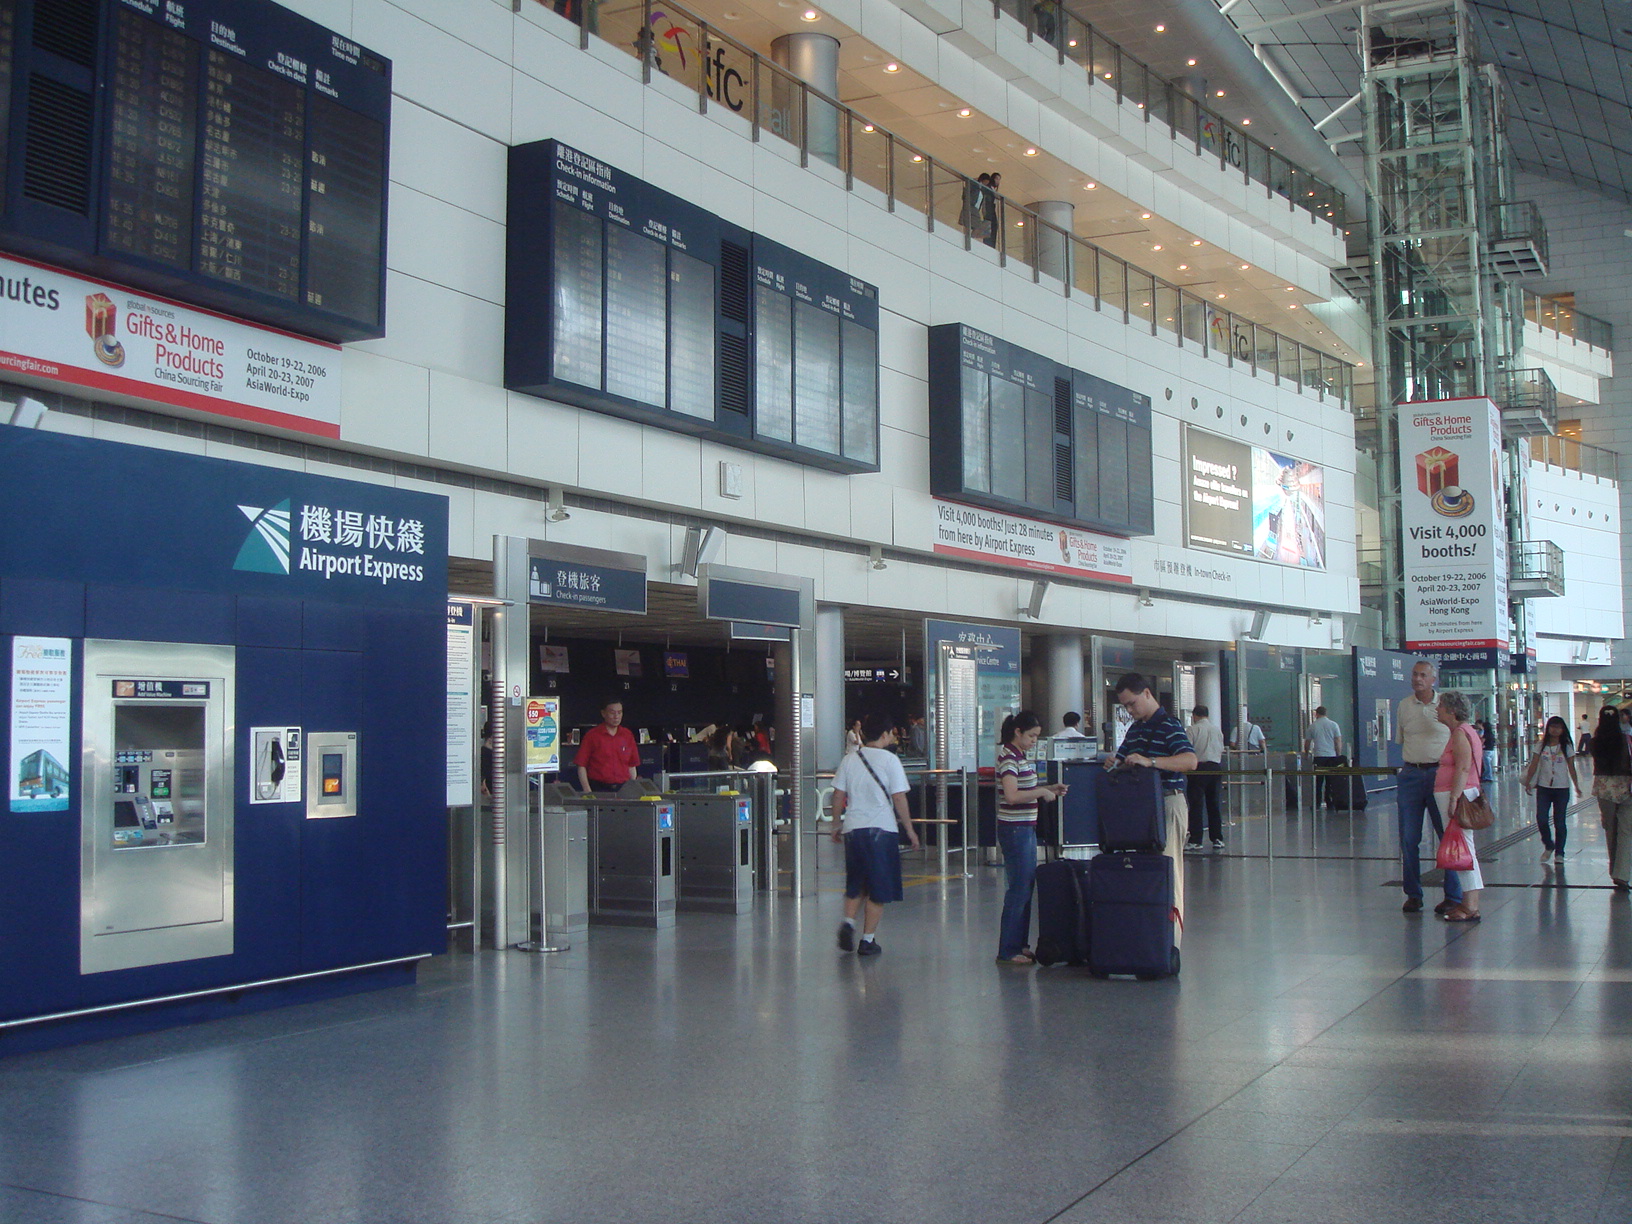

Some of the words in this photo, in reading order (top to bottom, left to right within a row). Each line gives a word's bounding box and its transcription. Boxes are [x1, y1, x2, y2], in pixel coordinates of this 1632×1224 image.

[165, 13, 186, 29] Flight
[210, 33, 247, 57] Destination
[332, 47, 345, 61] Time
[345, 55, 358, 66] now
[268, 59, 293, 78] Check-in
[293, 72, 308, 85] desk
[315, 81, 339, 99] Remarks
[556, 160, 582, 179] Check-in
[583, 171, 617, 194] information
[126, 299, 146, 313] global
[151, 306, 175, 320] sources
[126, 312, 163, 342] Gifts
[166, 322, 177, 345] &
[180, 325, 225, 356] Home
[155, 345, 225, 379] Products
[246, 348, 279, 367] October
[281, 356, 306, 373] 19-22,
[307, 363, 327, 378] 2006
[154, 367, 177, 382] China
[177, 372, 210, 393] Sourcing
[210, 379, 224, 393] Fair
[246, 363, 267, 378] April
[268, 368, 294, 385] 20-23,
[295, 373, 315, 389] 2007
[246, 377, 310, 402] AsiaWorld-Expo
[1413, 416, 1435, 427] Gifts
[1435, 416, 1443, 426] &
[1444, 415, 1472, 425] Home
[1430, 425, 1472, 436] Products
[299, 504, 426, 556] 機場快綫
[937, 504, 955, 523] Visit
[956, 509, 976, 527] 4,000
[977, 513, 1004, 533] booths!
[1004, 520, 1018, 536] Just
[1018, 523, 1028, 537] 28
[1028, 525, 1054, 542] minutes
[1410, 525, 1442, 540] Visit
[1445, 524, 1487, 541] 4,000
[938, 524, 956, 542] from
[957, 528, 973, 545] here
[974, 532, 984, 550] by
[984, 534, 1008, 553] Airport
[1009, 539, 1036, 557] Express
[1421, 543, 1477, 559] booths!
[299, 546, 362, 580] Airport
[363, 554, 424, 586] Express
[1077, 550, 1098, 563] Products
[556, 570, 601, 592] 登機旅客
[1194, 566, 1212, 579] In-town
[1212, 569, 1232, 582] Check-in
[1411, 573, 1441, 583] October
[1442, 573, 1466, 582] 19-22,
[1467, 572, 1487, 581] 2006
[555, 590, 578, 600] Check-in
[578, 594, 607, 605] passengers
[1417, 585, 1435, 594] April
[1437, 584, 1461, 592] 20-23,
[1462, 583, 1481, 591] 2007
[1419, 597, 1480, 607] AsiaWorld-Expo
[1429, 607, 1449, 616] Hong
[1450, 606, 1470, 616] Kong
